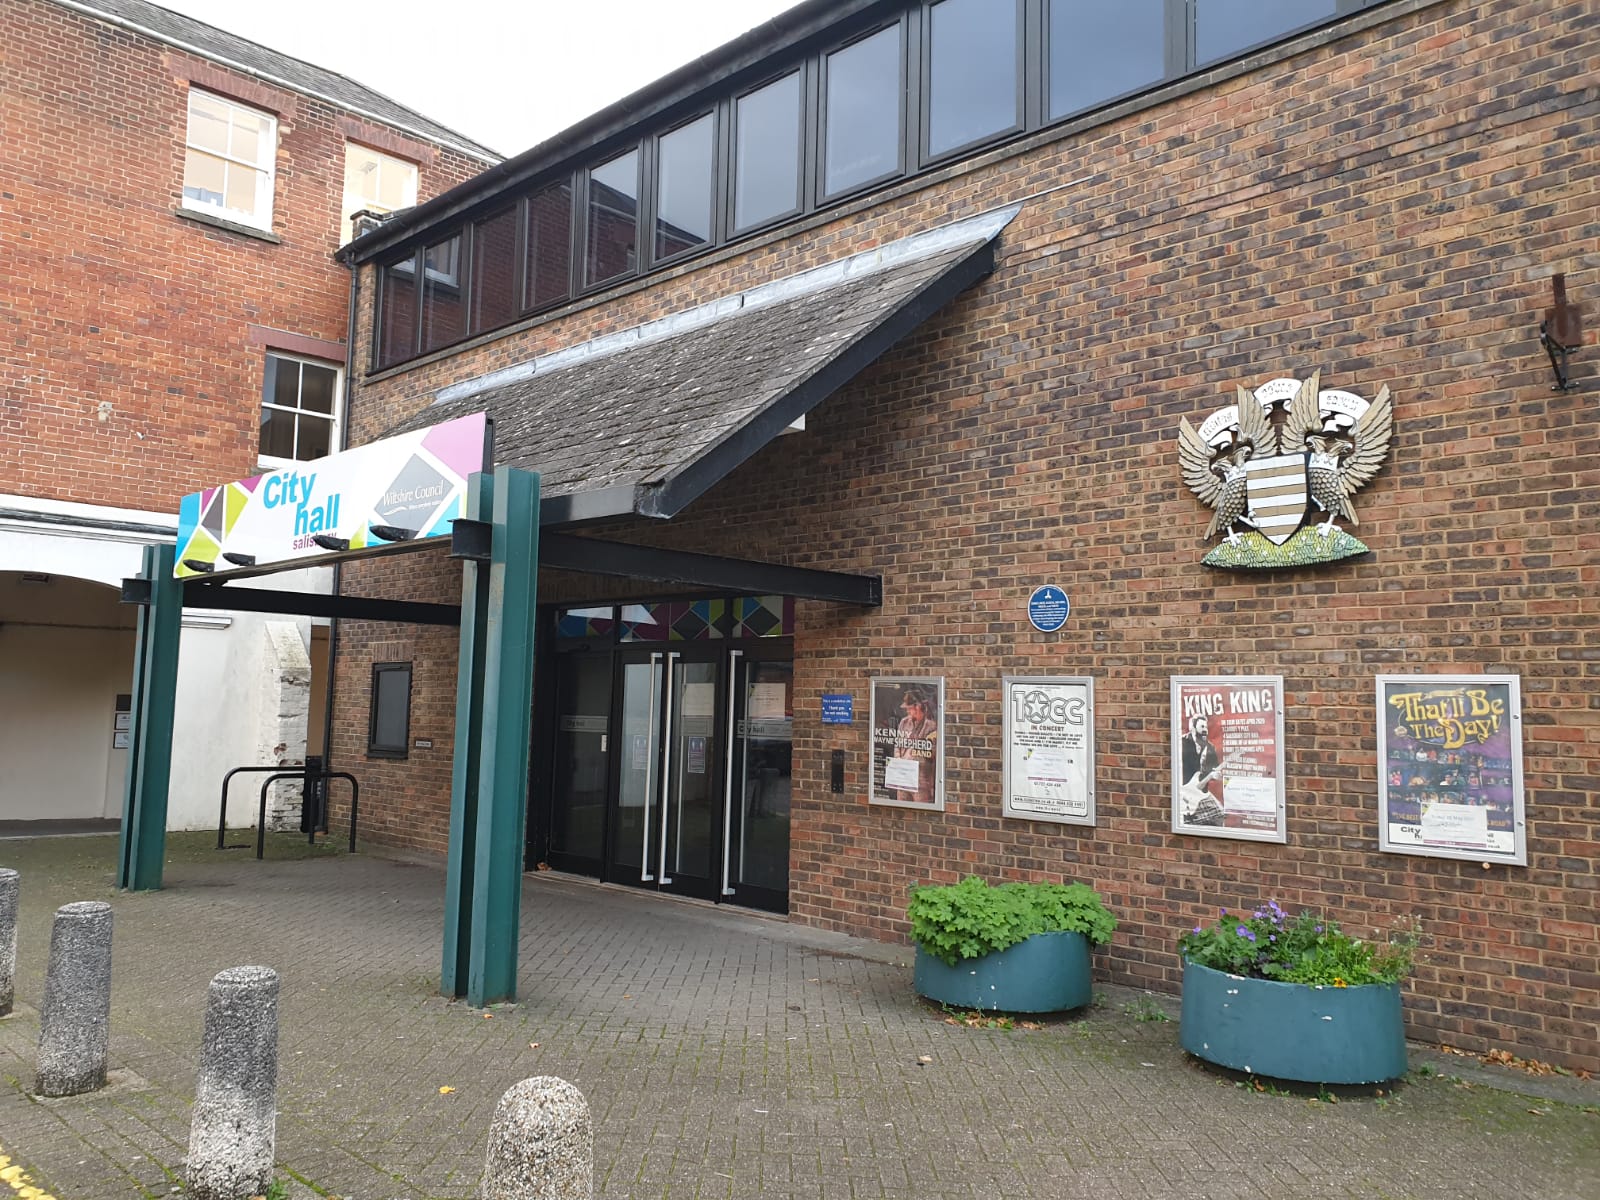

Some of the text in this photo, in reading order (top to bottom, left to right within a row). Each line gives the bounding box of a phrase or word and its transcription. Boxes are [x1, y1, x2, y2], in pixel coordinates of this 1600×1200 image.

[263, 470, 317, 509] City
[383, 488, 413, 506] Wiltshire
[415, 479, 444, 499] Council
[294, 493, 340, 536] hall
[293, 532, 337, 550] salis
[1183, 689, 1273, 717] KING KING
[1466, 689, 1505, 716] Be
[874, 736, 932, 751] WAYNE SHEPHERD
[875, 728, 913, 739] KENNY
[1410, 715, 1499, 749] The Day!
[911, 749, 932, 757] BAND
[1400, 826, 1421, 835] City
